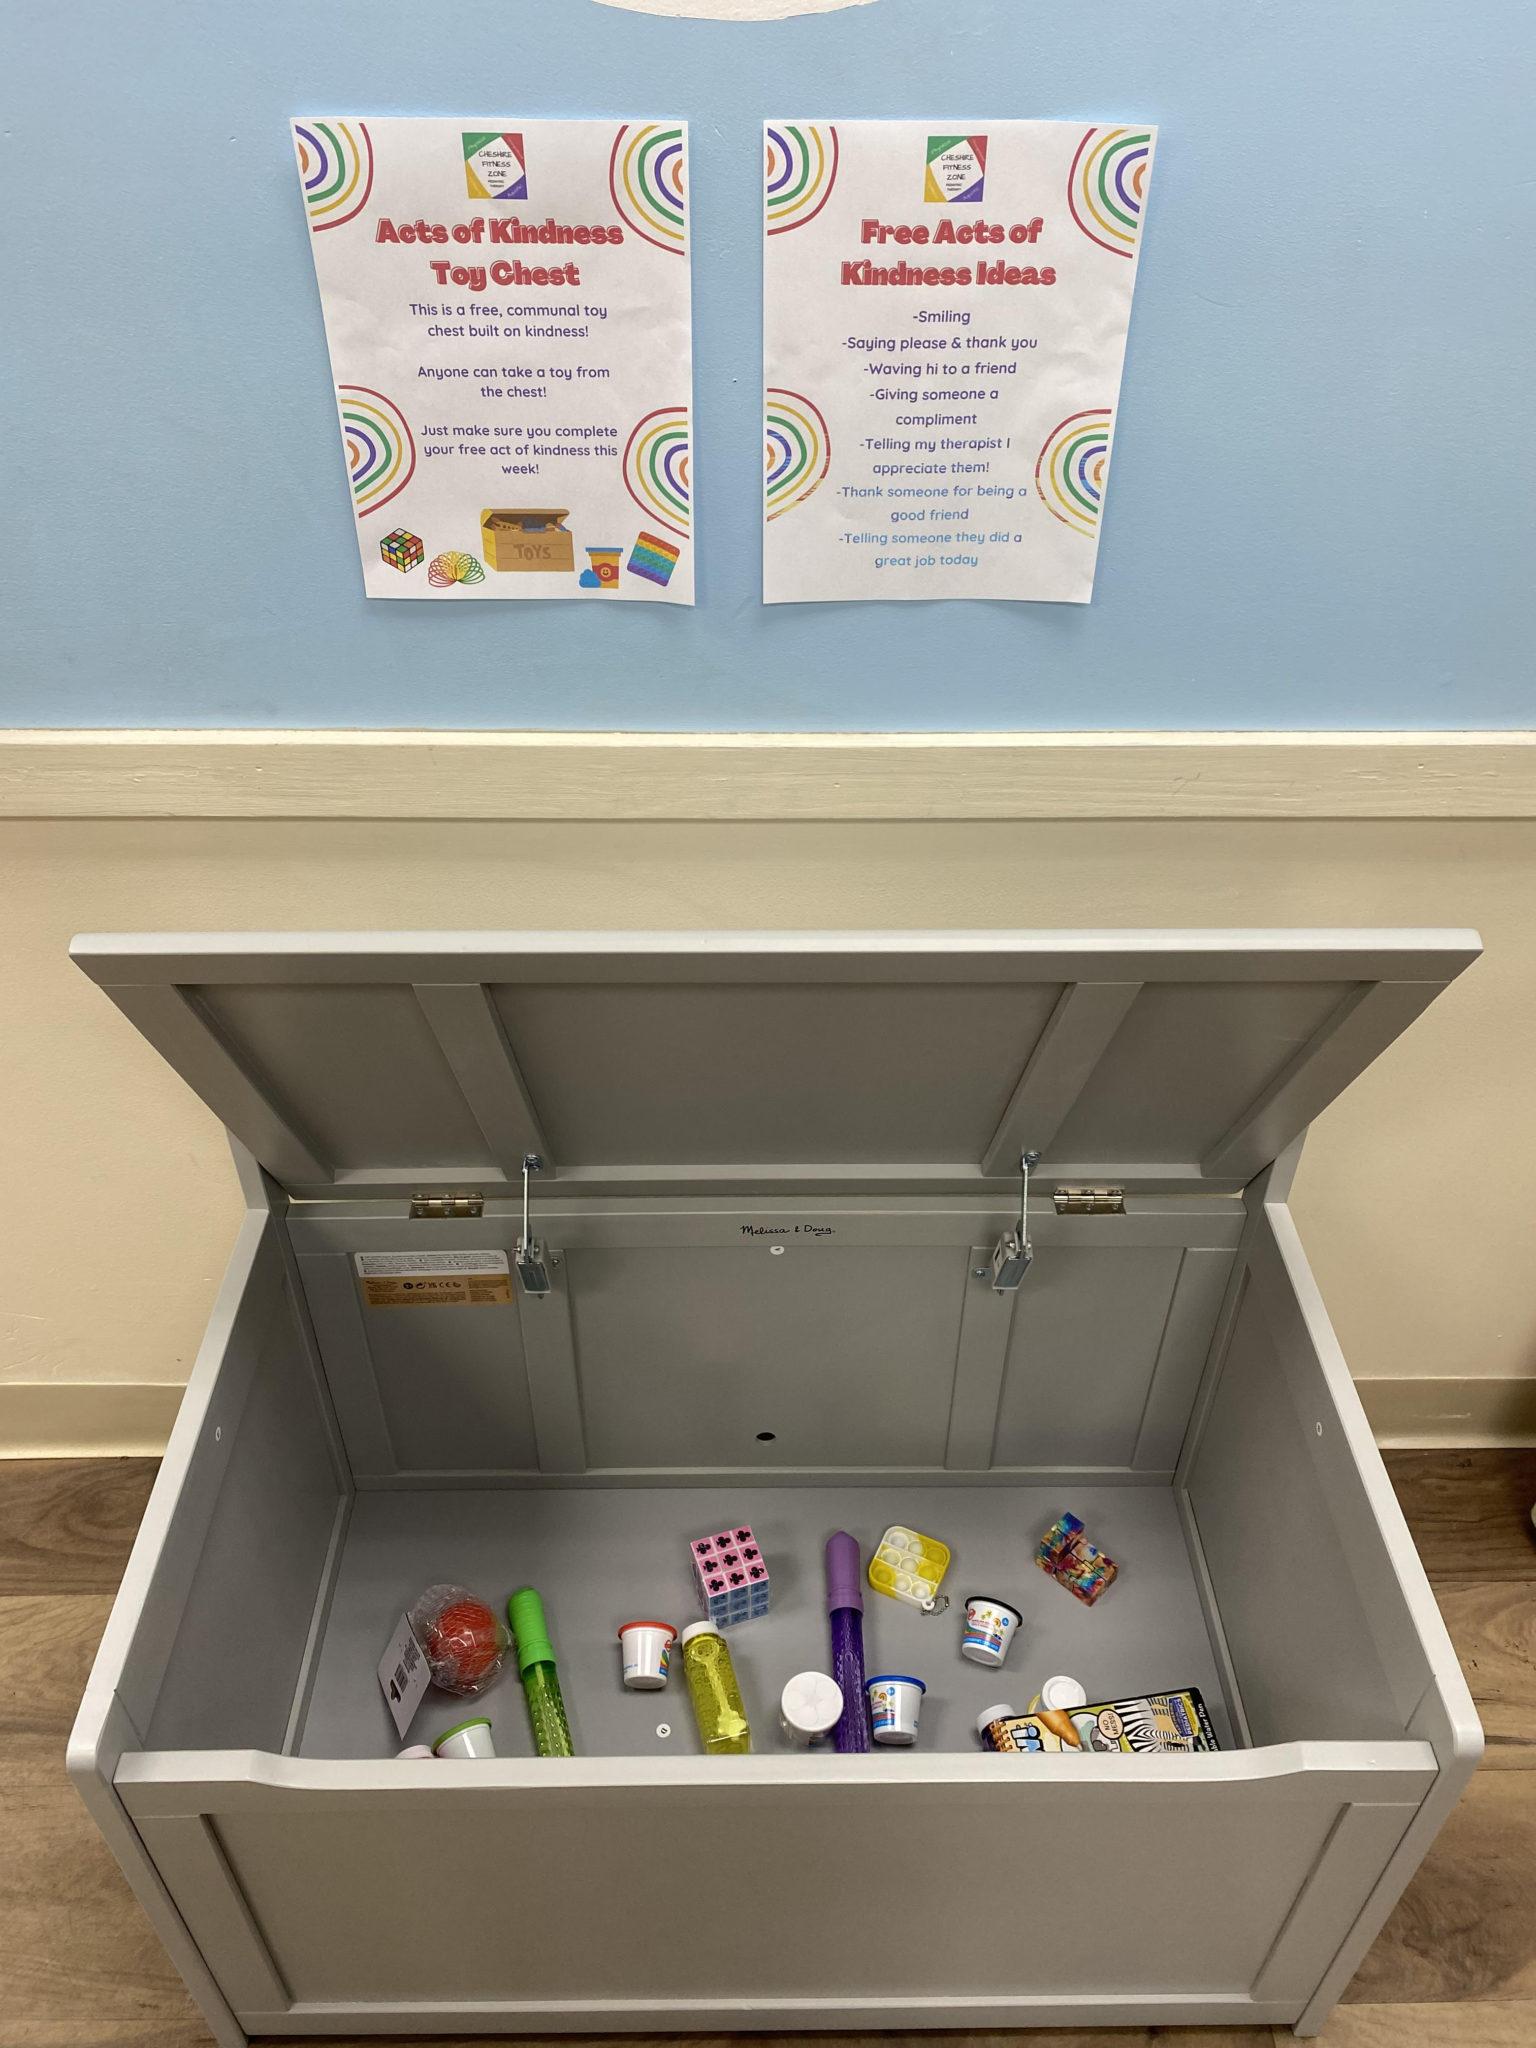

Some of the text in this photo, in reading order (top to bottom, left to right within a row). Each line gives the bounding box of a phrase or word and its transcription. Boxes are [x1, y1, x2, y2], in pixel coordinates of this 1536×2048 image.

[478, 150, 512, 158] CHESHIRE
[375, 217, 624, 244] Acts of Kindness
[861, 217, 1043, 245] Free Acts of
[430, 260, 580, 292] Toy Chest
[841, 259, 1056, 286] Kindness Ideas
[409, 304, 607, 319] This is a free, communal toy
[913, 310, 970, 325] -Smiling
[428, 325, 588, 337] chest built on kindness!
[842, 336, 1037, 352] -Saying please & thank you
[418, 366, 609, 380] Anyone can take a toy from
[864, 362, 1016, 377] -Waving hi to a friend
[481, 386, 546, 397] the chest!
[869, 388, 998, 403] -Giving someone a
[896, 414, 977, 428] compliment
[421, 425, 617, 439] Just make sure you complete
[424, 444, 617, 457] your free act of kindness this
[860, 437, 1011, 452] -Telling my therapist I
[502, 464, 539, 474] week!
[873, 462, 989, 476] appreciate them!
[836, 485, 1026, 499] -Thank someone for being a
[891, 508, 969, 522] good friend
[839, 533, 888, 545] -Telling
[892, 535, 952, 543] someone
[956, 531, 985, 544] they
[990, 532, 1009, 542] did
[513, 544, 551, 560] TOYS
[875, 554, 978, 568] great job today
[740, 1225, 790, 1236] Melissa
[1197, 1703, 1206, 1718] Pen
[1102, 1719, 1111, 1731] NO
[1108, 1713, 1119, 1735] MESS!
[1202, 1719, 1213, 1739] Water
